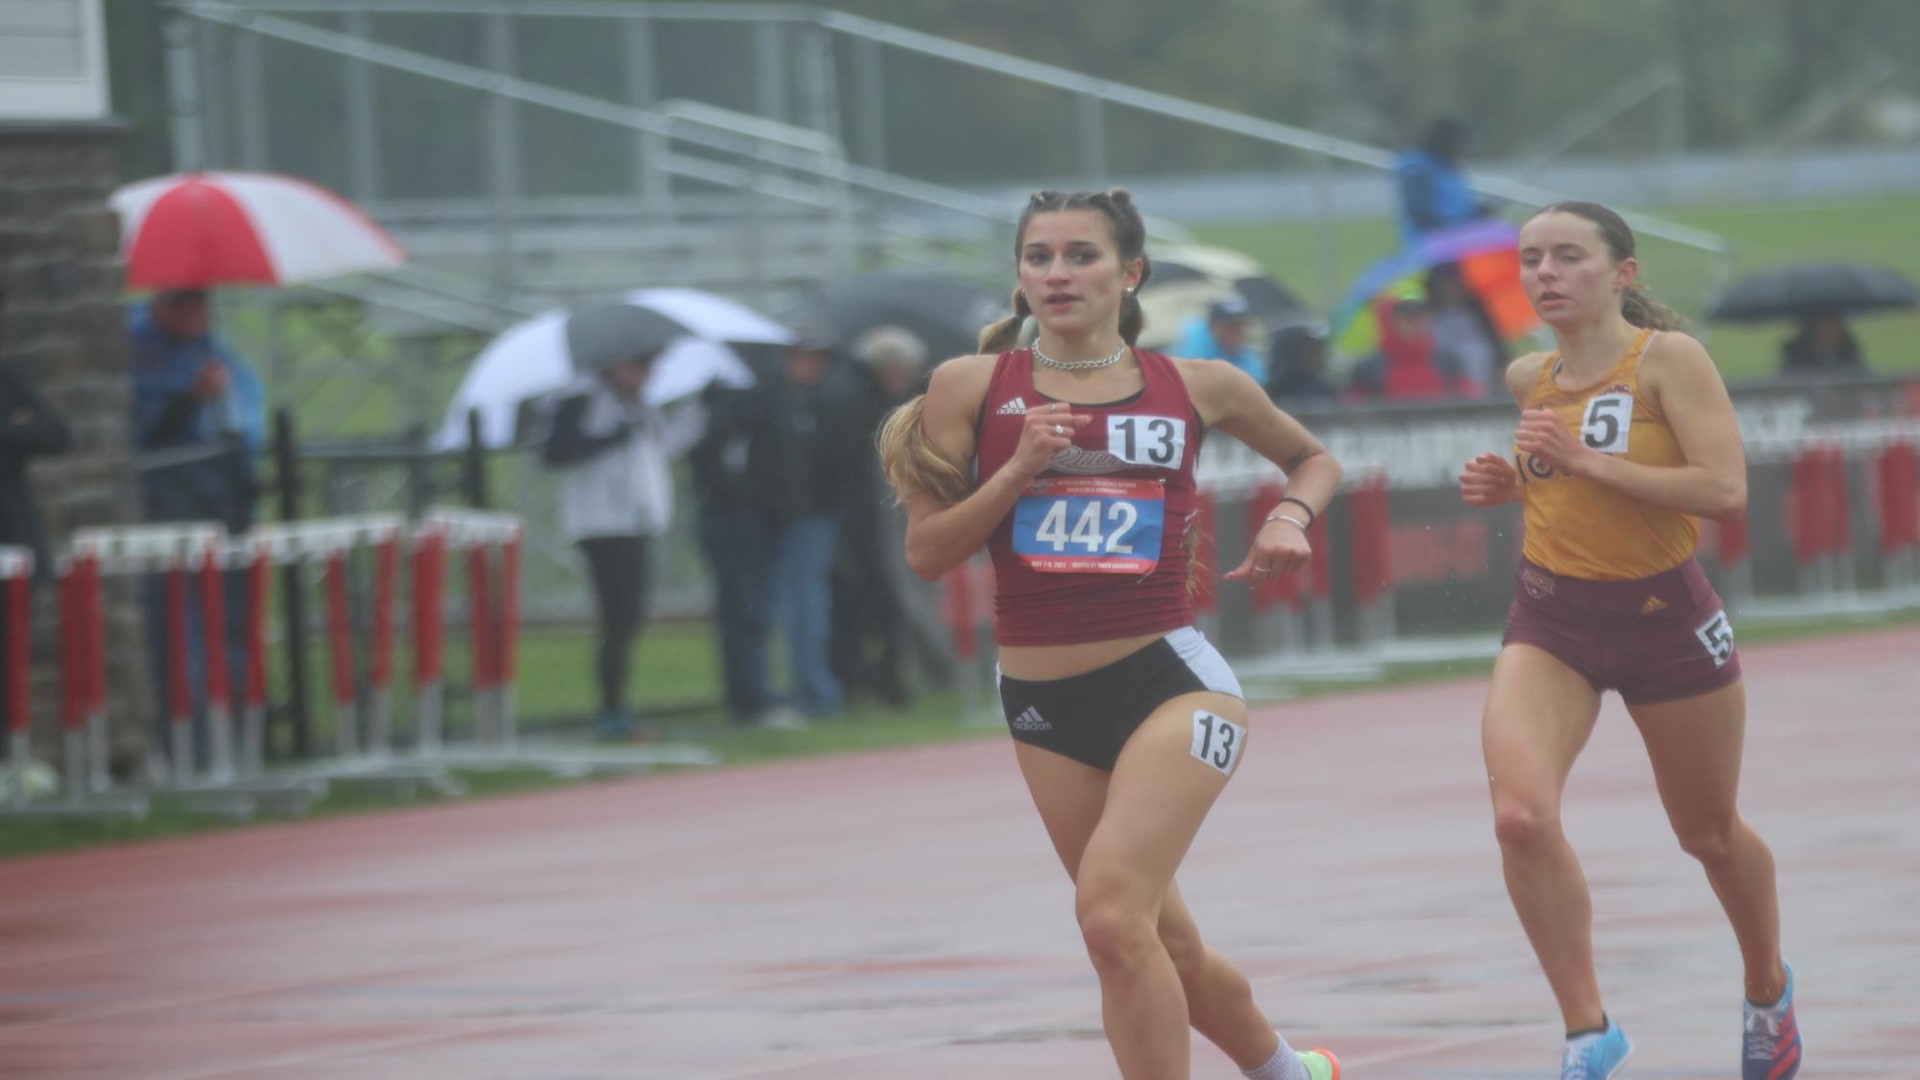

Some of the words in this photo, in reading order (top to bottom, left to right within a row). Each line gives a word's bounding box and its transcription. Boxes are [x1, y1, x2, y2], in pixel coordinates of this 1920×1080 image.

[1115, 418, 1175, 464] 13
[1585, 399, 1620, 448] 5
[1036, 500, 1138, 554] 442
[1705, 618, 1734, 659] 5
[1013, 721, 1052, 731] adidas
[1199, 715, 1235, 769] 13
